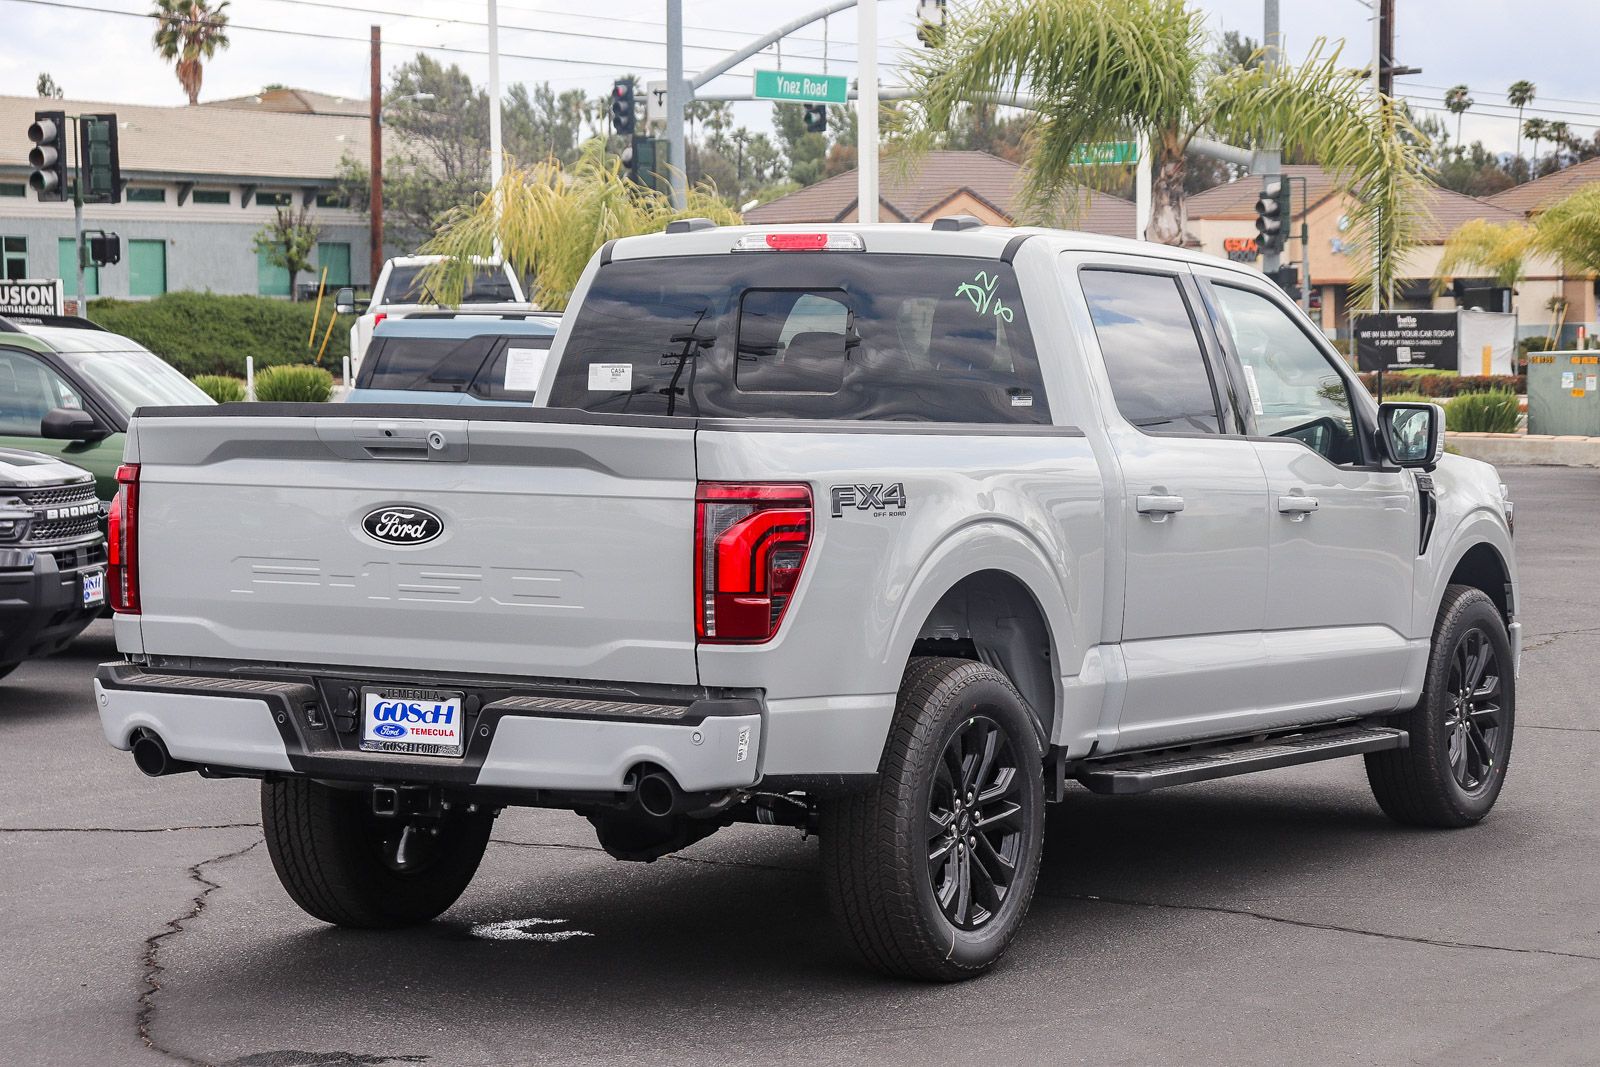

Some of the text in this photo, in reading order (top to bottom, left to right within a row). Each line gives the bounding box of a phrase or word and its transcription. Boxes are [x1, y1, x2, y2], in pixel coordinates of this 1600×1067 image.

[777, 76, 829, 96] Ynez Road
[1225, 239, 1258, 252] ESCA
[0, 305, 55, 316] ISTIAN CHURCH
[1420, 329, 1432, 338] CAR
[830, 483, 907, 518] FX4
[47, 503, 99, 520] BRONCO
[375, 511, 428, 538] Ford
[386, 689, 441, 700] TEMECULA
[380, 725, 455, 737] Ford TEMECULA
